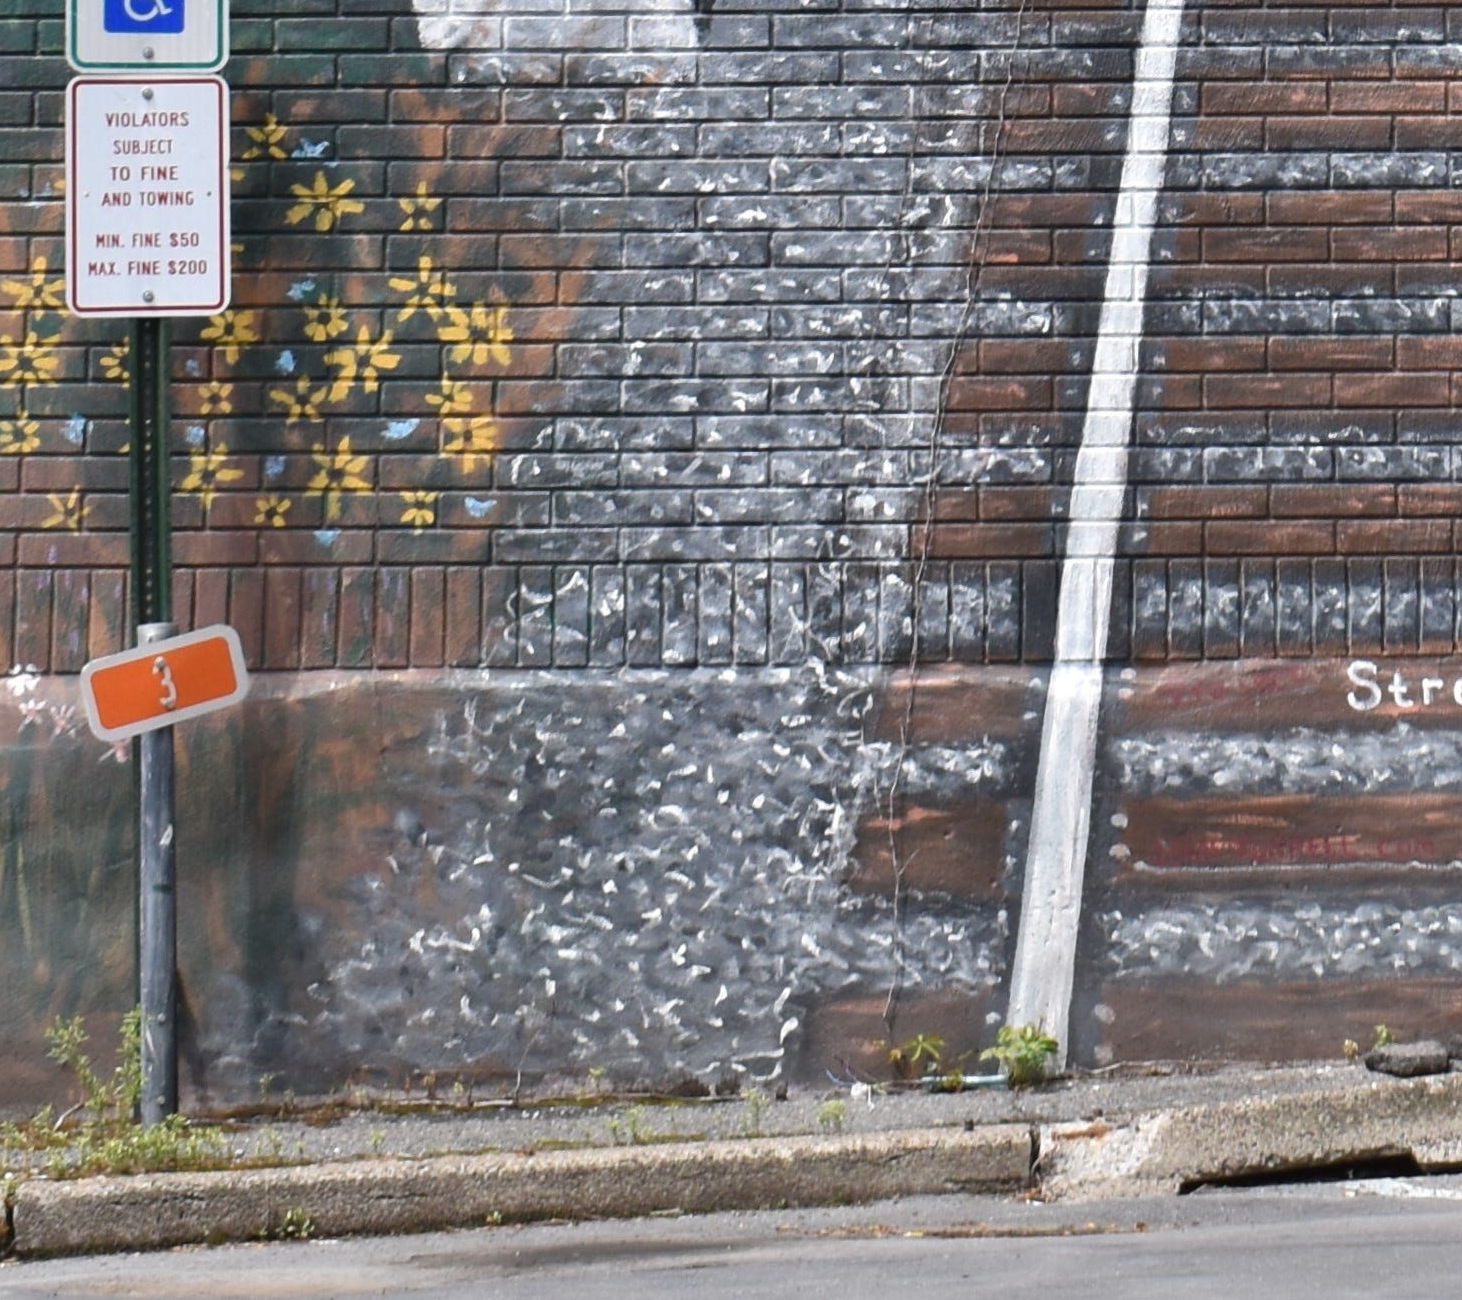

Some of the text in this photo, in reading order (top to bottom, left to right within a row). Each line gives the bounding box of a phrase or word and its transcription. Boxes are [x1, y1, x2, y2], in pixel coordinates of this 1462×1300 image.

[106, 112, 189, 127] VIOLATORS
[114, 140, 172, 154] SUBJECT
[111, 166, 178, 181] TO FINE
[102, 192, 193, 206] AND TOWING
[96, 233, 199, 248] MIN. FINE $50
[89, 260, 207, 276] MAX. FINE $200
[152, 657, 177, 710] 3
